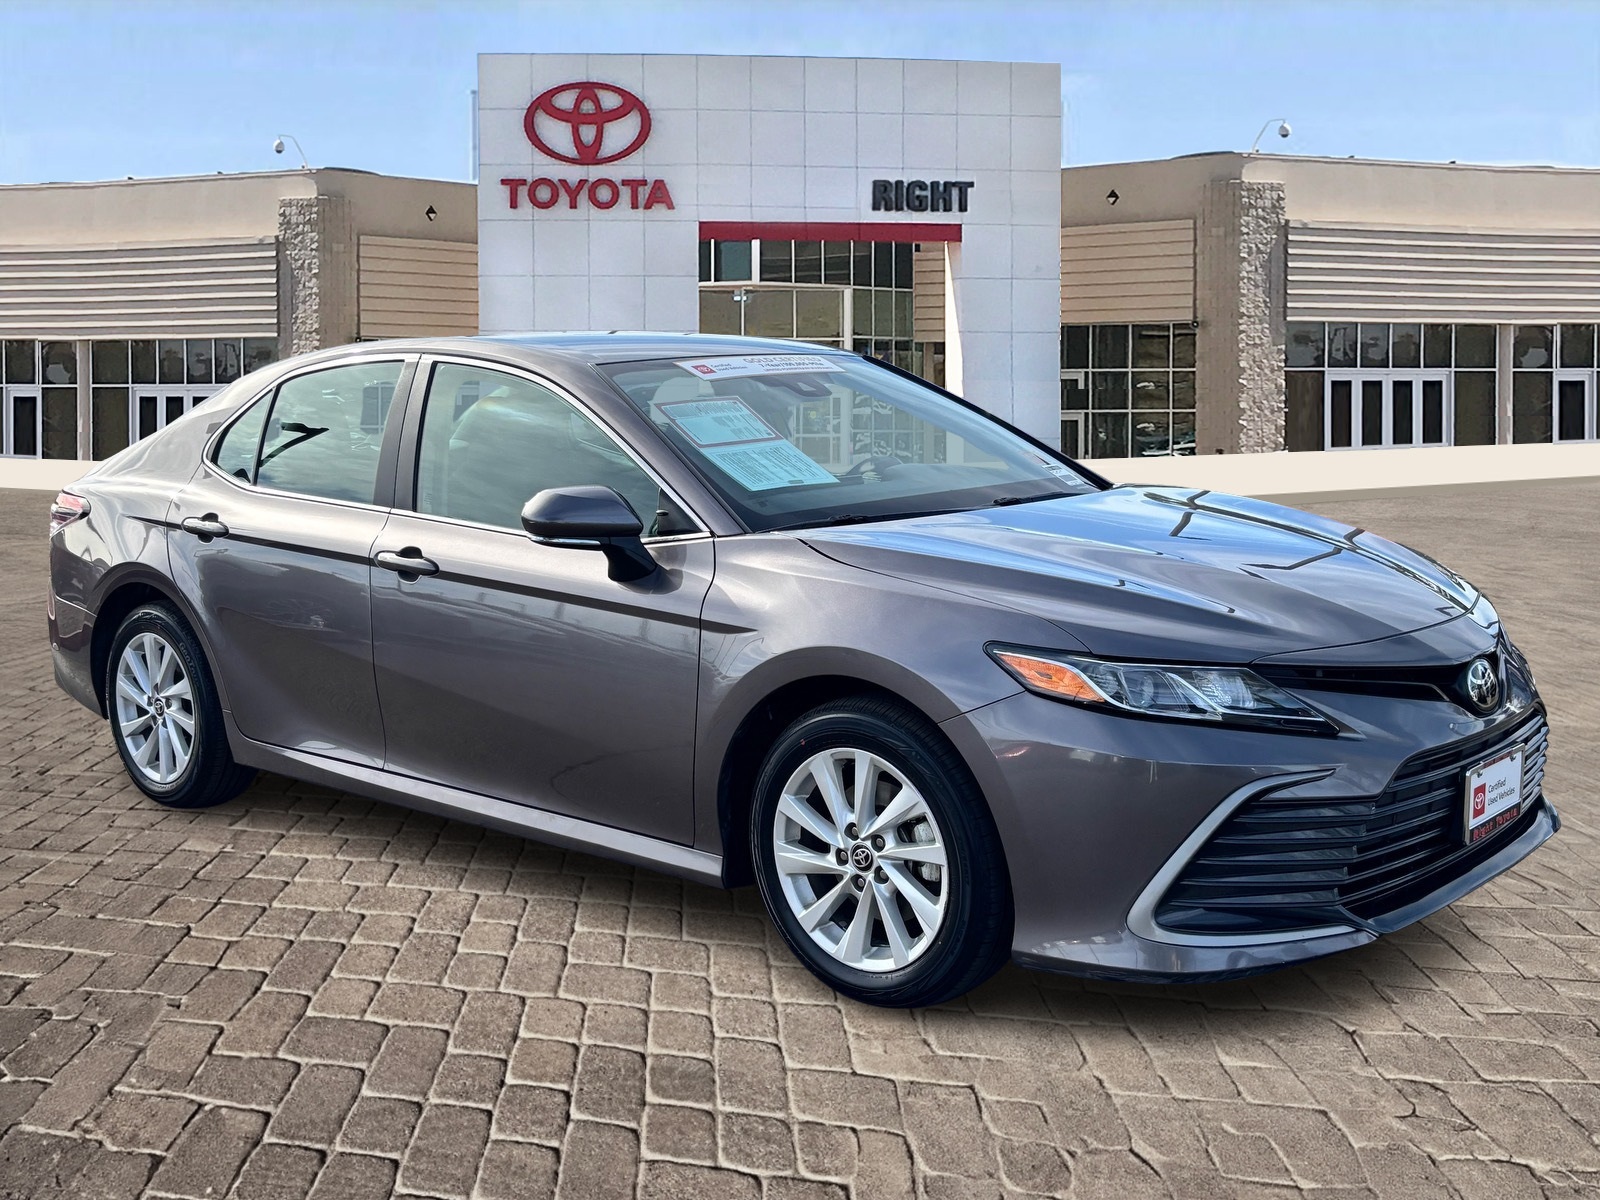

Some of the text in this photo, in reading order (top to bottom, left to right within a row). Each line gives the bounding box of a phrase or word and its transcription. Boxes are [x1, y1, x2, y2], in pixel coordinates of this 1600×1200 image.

[500, 177, 675, 210] TOYOTA
[872, 179, 974, 212] RIGHT
[1487, 786, 1515, 806] Used Vehicles
[1488, 777, 1507, 793] Certified
[1473, 808, 1518, 840] Right Toyota
